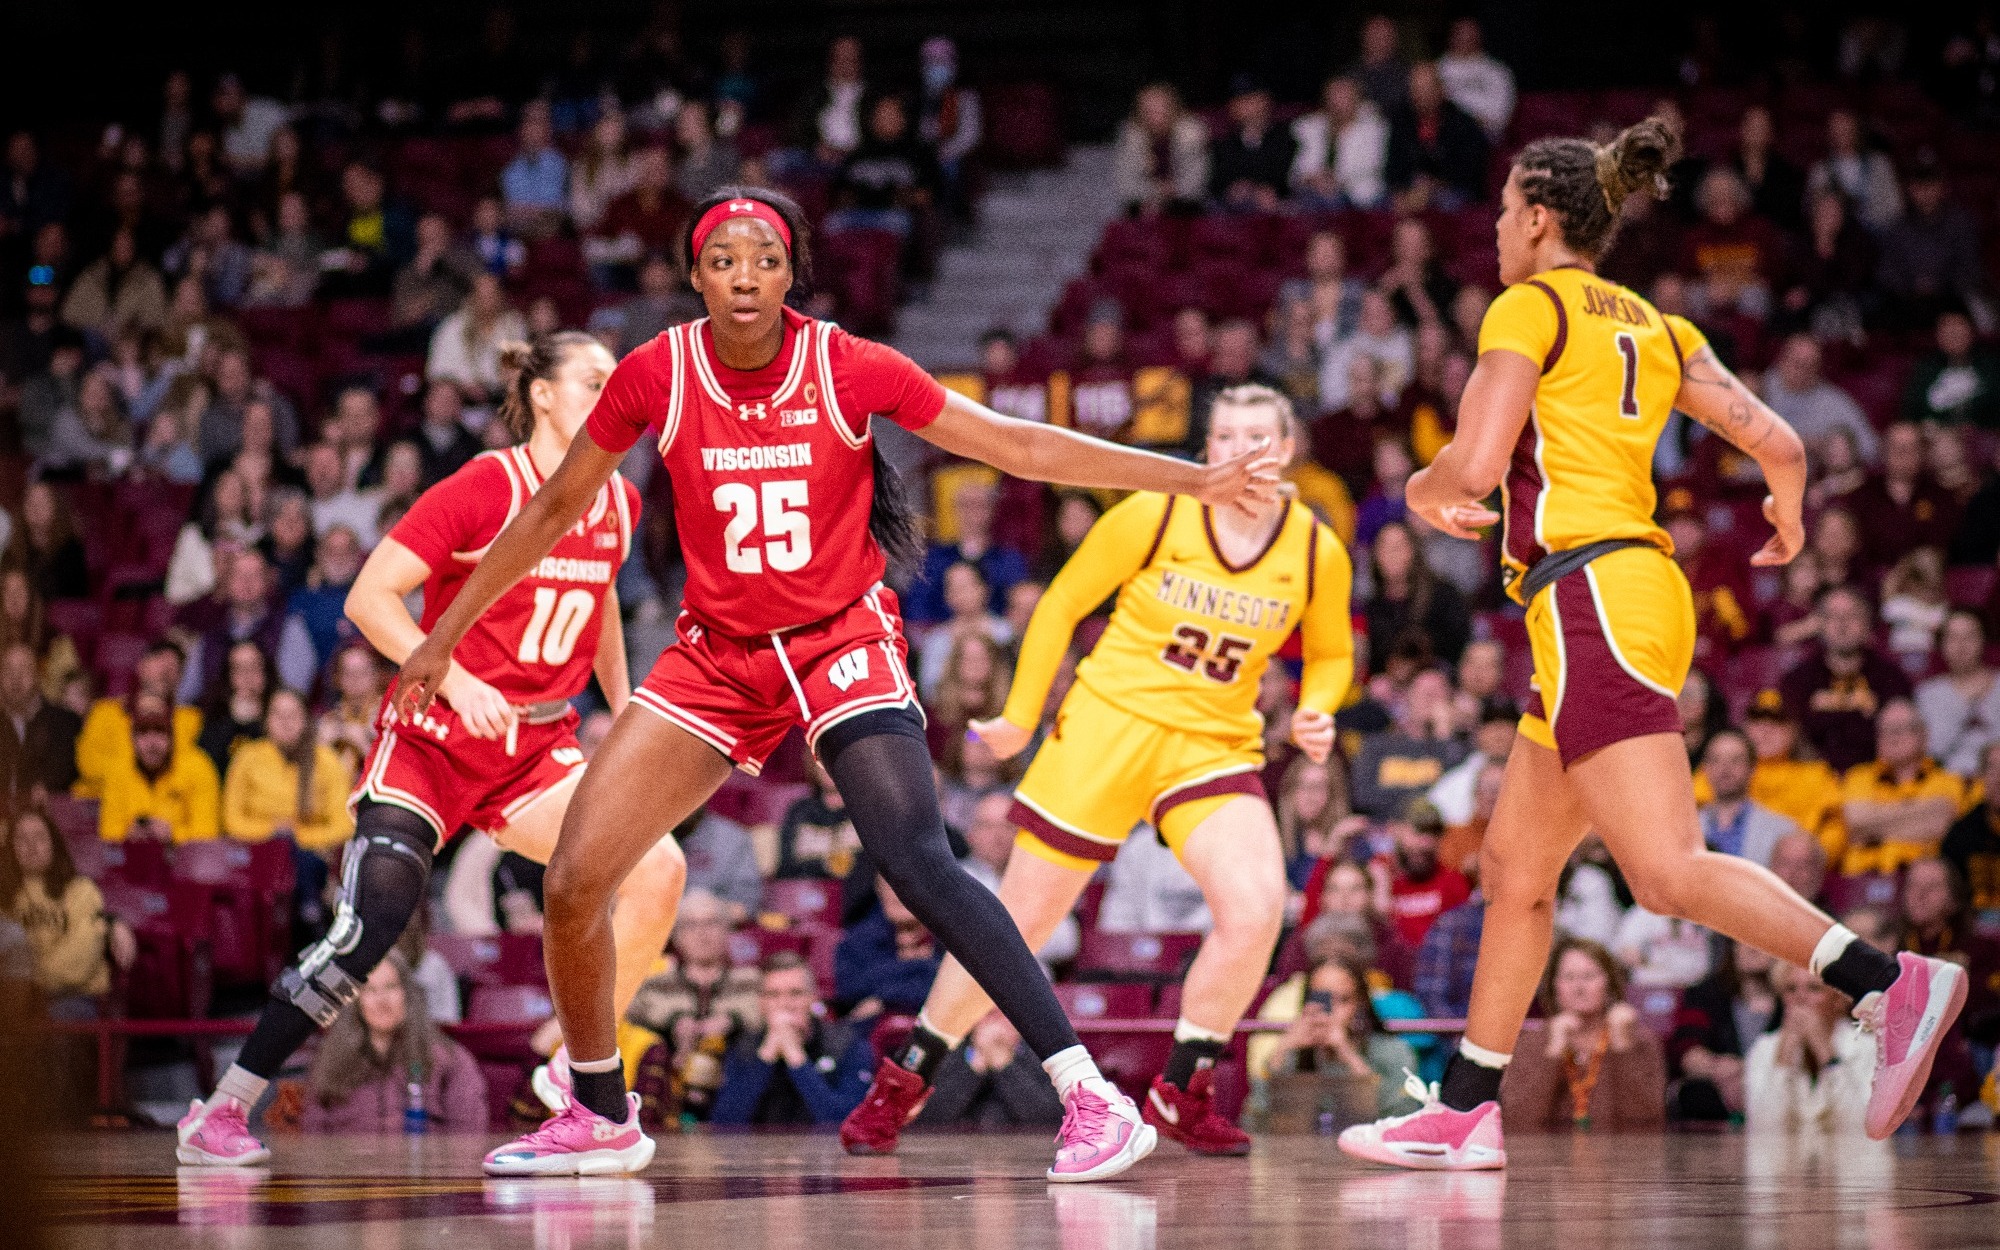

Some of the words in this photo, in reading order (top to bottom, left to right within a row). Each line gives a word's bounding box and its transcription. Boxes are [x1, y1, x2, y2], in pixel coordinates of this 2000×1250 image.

[1615, 331, 1640, 419] 1
[701, 443, 812, 471] WISCONSIN
[712, 479, 812, 574] 25
[517, 586, 595, 666] 10
[1156, 569, 1290, 631] MINNESOTA
[828, 647, 869, 692] W
[1160, 622, 1256, 684] 25
